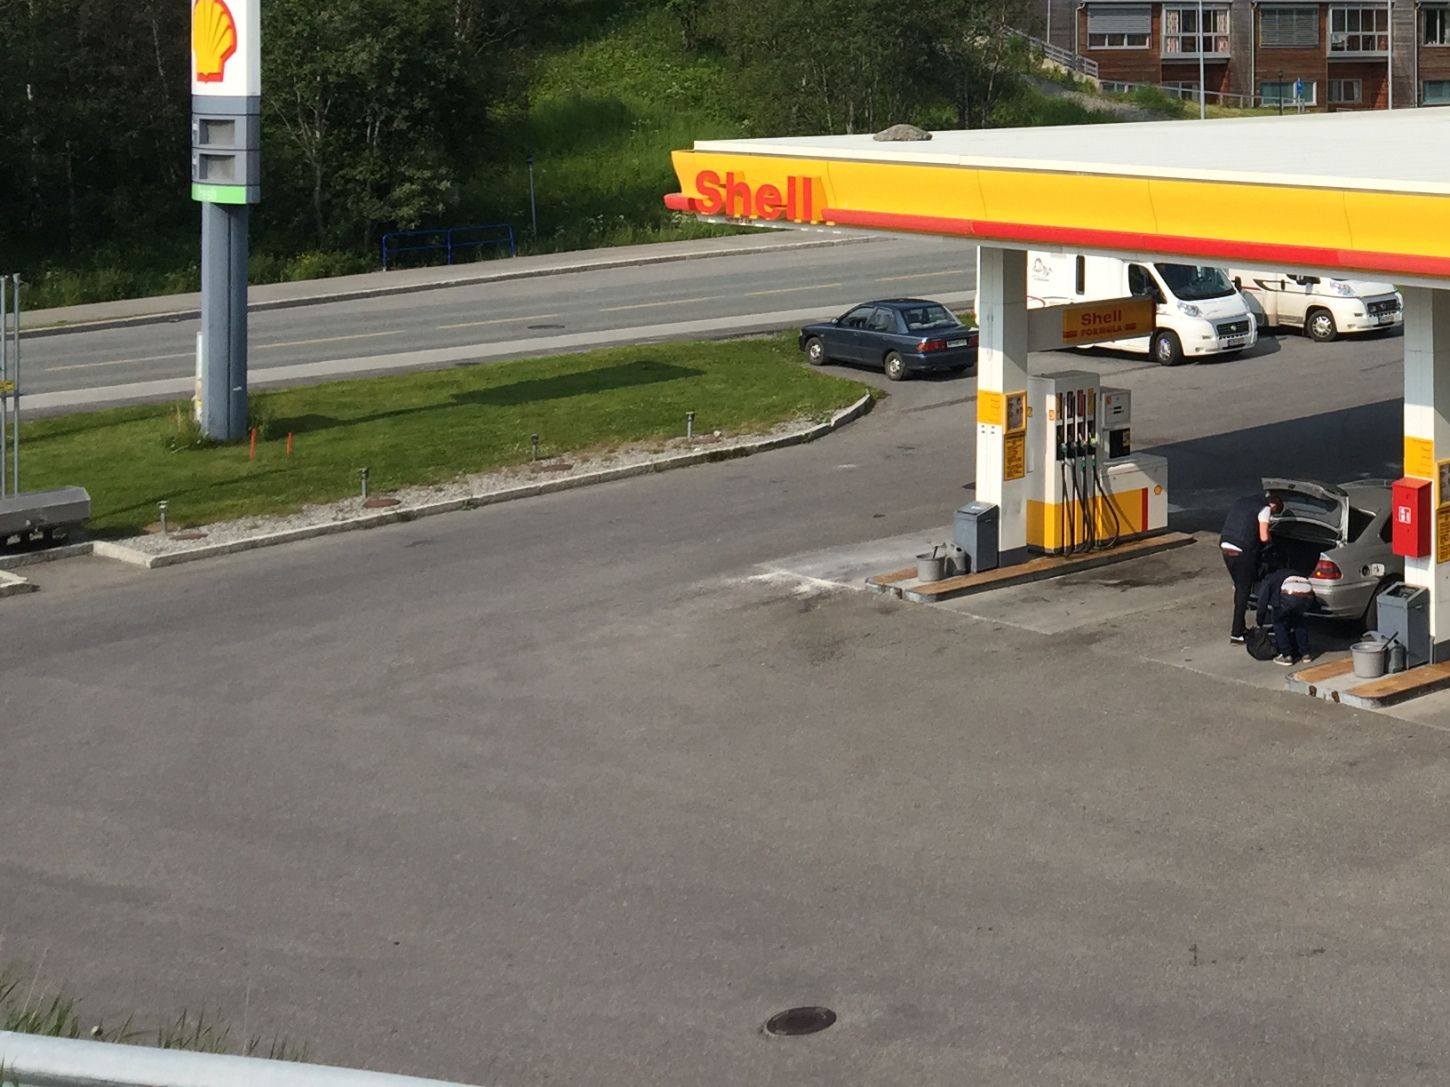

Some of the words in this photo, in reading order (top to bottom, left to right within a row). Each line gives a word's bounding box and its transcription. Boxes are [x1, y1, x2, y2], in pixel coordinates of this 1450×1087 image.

[696, 170, 812, 220] Shell
[1081, 310, 1122, 326] Shell
[1080, 324, 1123, 337] FORMULA
